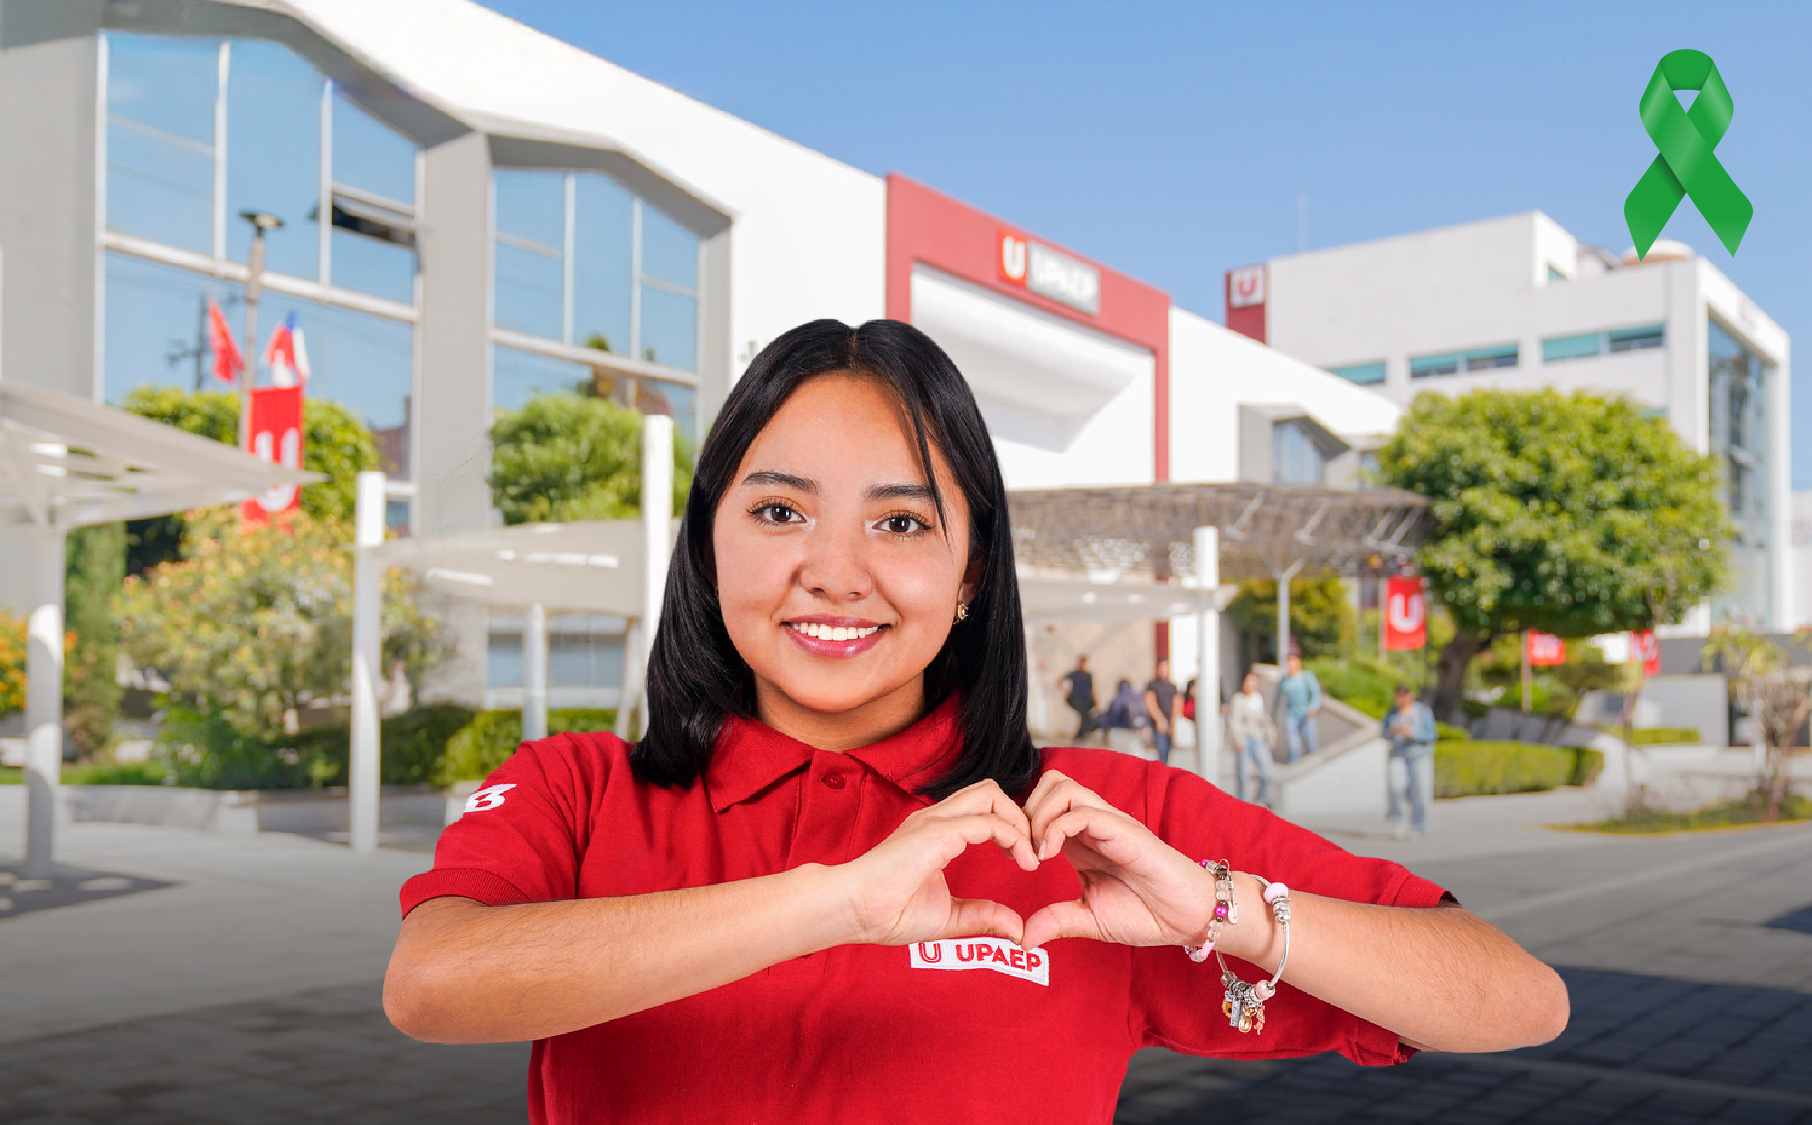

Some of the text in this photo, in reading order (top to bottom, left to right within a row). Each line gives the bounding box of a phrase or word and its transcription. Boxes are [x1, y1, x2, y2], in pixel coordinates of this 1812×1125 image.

[1002, 235, 1026, 280] U
[1238, 276, 1256, 298] U
[1390, 592, 1424, 633] U
[918, 942, 1042, 972] U UPAEP
